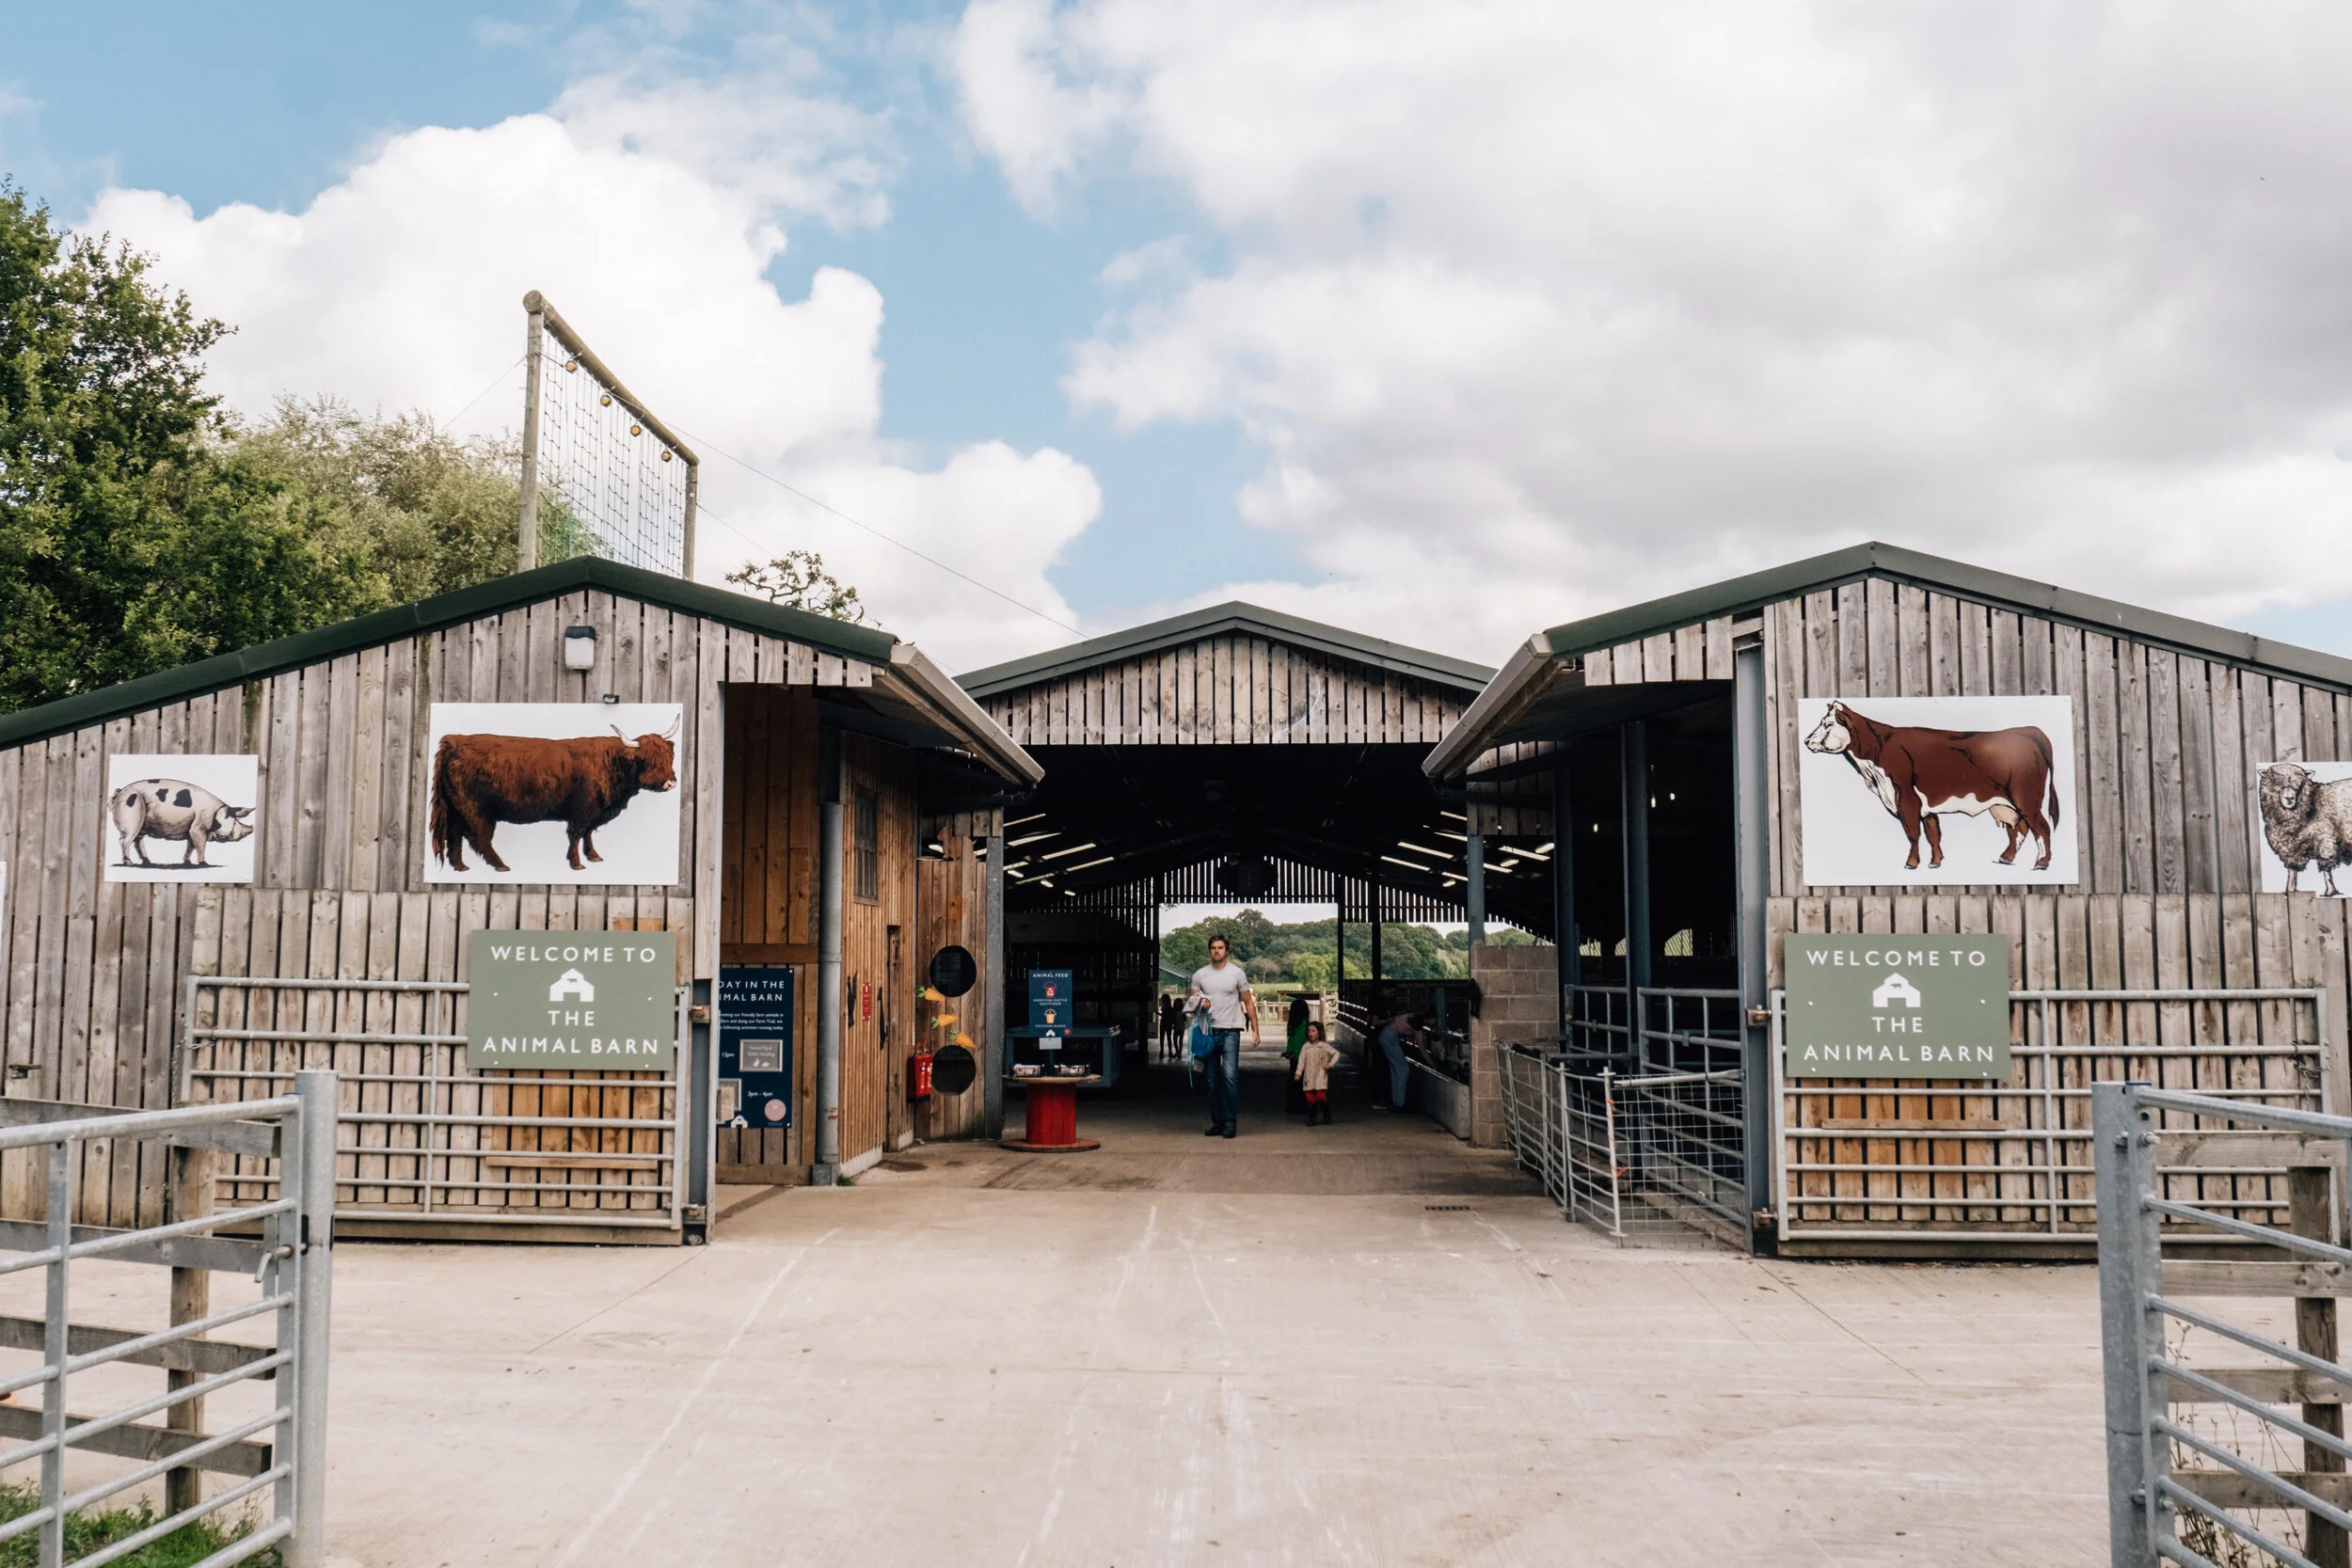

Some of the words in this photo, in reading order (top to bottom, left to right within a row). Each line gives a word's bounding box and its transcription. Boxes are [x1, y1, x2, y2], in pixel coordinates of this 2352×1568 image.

[491, 945, 613, 962] WELCOME
[624, 947, 656, 962] TO
[1806, 950, 1940, 966] WELCOME
[1950, 950, 1986, 967] TO
[745, 980, 758, 989] IN
[762, 980, 785, 989] THE
[719, 993, 747, 1002] IMAL
[751, 993, 783, 1002] BARN
[548, 1010, 595, 1026] THE
[1871, 1016, 1923, 1033] THE
[482, 1037, 580, 1053] ANIMAL
[591, 1037, 658, 1054] BARN
[1804, 1044, 1910, 1061] ANIMAL
[1920, 1045, 1994, 1062] BARN
